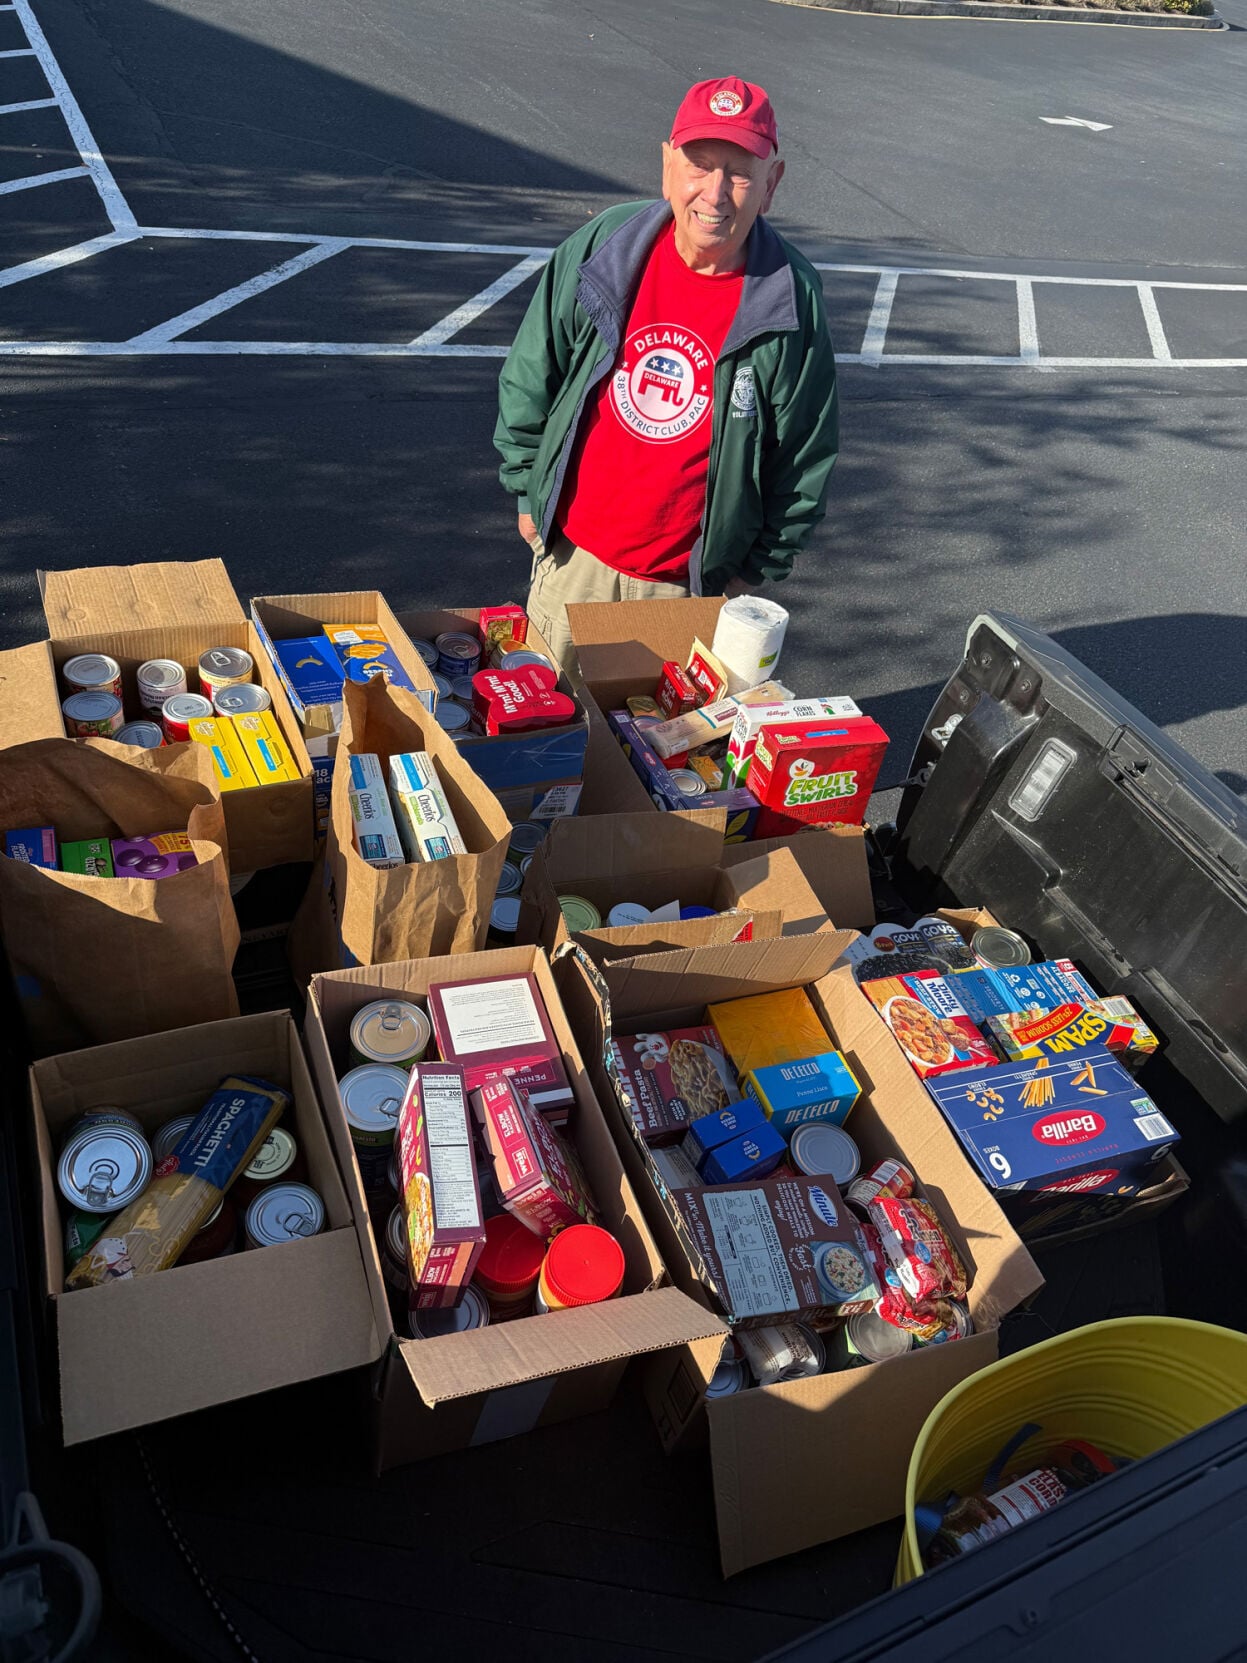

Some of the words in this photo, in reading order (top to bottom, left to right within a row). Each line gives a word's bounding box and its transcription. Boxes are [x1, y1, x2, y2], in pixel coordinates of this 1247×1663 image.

[634, 331, 708, 370] DELAWARE
[617, 376, 627, 399] 38TH
[644, 373, 678, 388] DELAWARE
[621, 401, 658, 435] DISTRICT
[690, 398, 706, 419] PAC
[484, 675, 506, 693] M'm!
[503, 680, 525, 703] Good!
[498, 693, 518, 714] M'm!
[793, 705, 812, 713] CORN
[315, 769, 328, 777] 18
[788, 772, 856, 794] FRUIT
[360, 793, 376, 820] Cheerios
[785, 784, 856, 806] SWIRLS
[417, 794, 437, 822] Cheerios
[923, 925, 957, 937] GOYA
[914, 979, 928, 996] BEEF
[926, 996, 942, 1015] STEW
[926, 981, 953, 1014] Moore
[938, 983, 959, 1009] Dinty
[1026, 1022, 1052, 1037] SODIUM
[1050, 1013, 1063, 1026] LESS
[1044, 1012, 1106, 1054] SPAM
[512, 1073, 546, 1085] PENNE
[793, 1063, 820, 1078] CECCO
[1014, 1070, 1038, 1080] SPAGHETTI
[634, 1068, 649, 1100] Pasta
[641, 1101, 657, 1127] Beef
[784, 1109, 802, 1123] DE
[801, 1100, 840, 1119] CECCO
[194, 1098, 245, 1168] SPAGHETTI
[497, 1112, 510, 1137] ELBOW
[1041, 1115, 1097, 1140] Barilla
[983, 1145, 1000, 1153] BOXES
[514, 1151, 527, 1174] weis
[989, 1153, 1012, 1179] 6
[751, 1195, 765, 1222] NOTHING
[772, 1199, 787, 1221] enjoy!
[775, 1183, 789, 1210] DELICIOUS
[785, 1211, 795, 1228] MEALS
[807, 1185, 839, 1227] Minute
[684, 1192, 697, 1209] MIX
[693, 1219, 709, 1244] Make
[705, 1251, 721, 1279] yours!
[761, 1223, 773, 1243] ADDED
[803, 1213, 815, 1235] MISSION
[760, 1204, 773, 1224] SIMPLY
[768, 1225, 781, 1252] COOKED,
[777, 1253, 787, 1270] THEN
[783, 1271, 794, 1292] DRIED.
[768, 1244, 777, 1256] BUT
[772, 1257, 791, 1304] CONVENIENCE.
